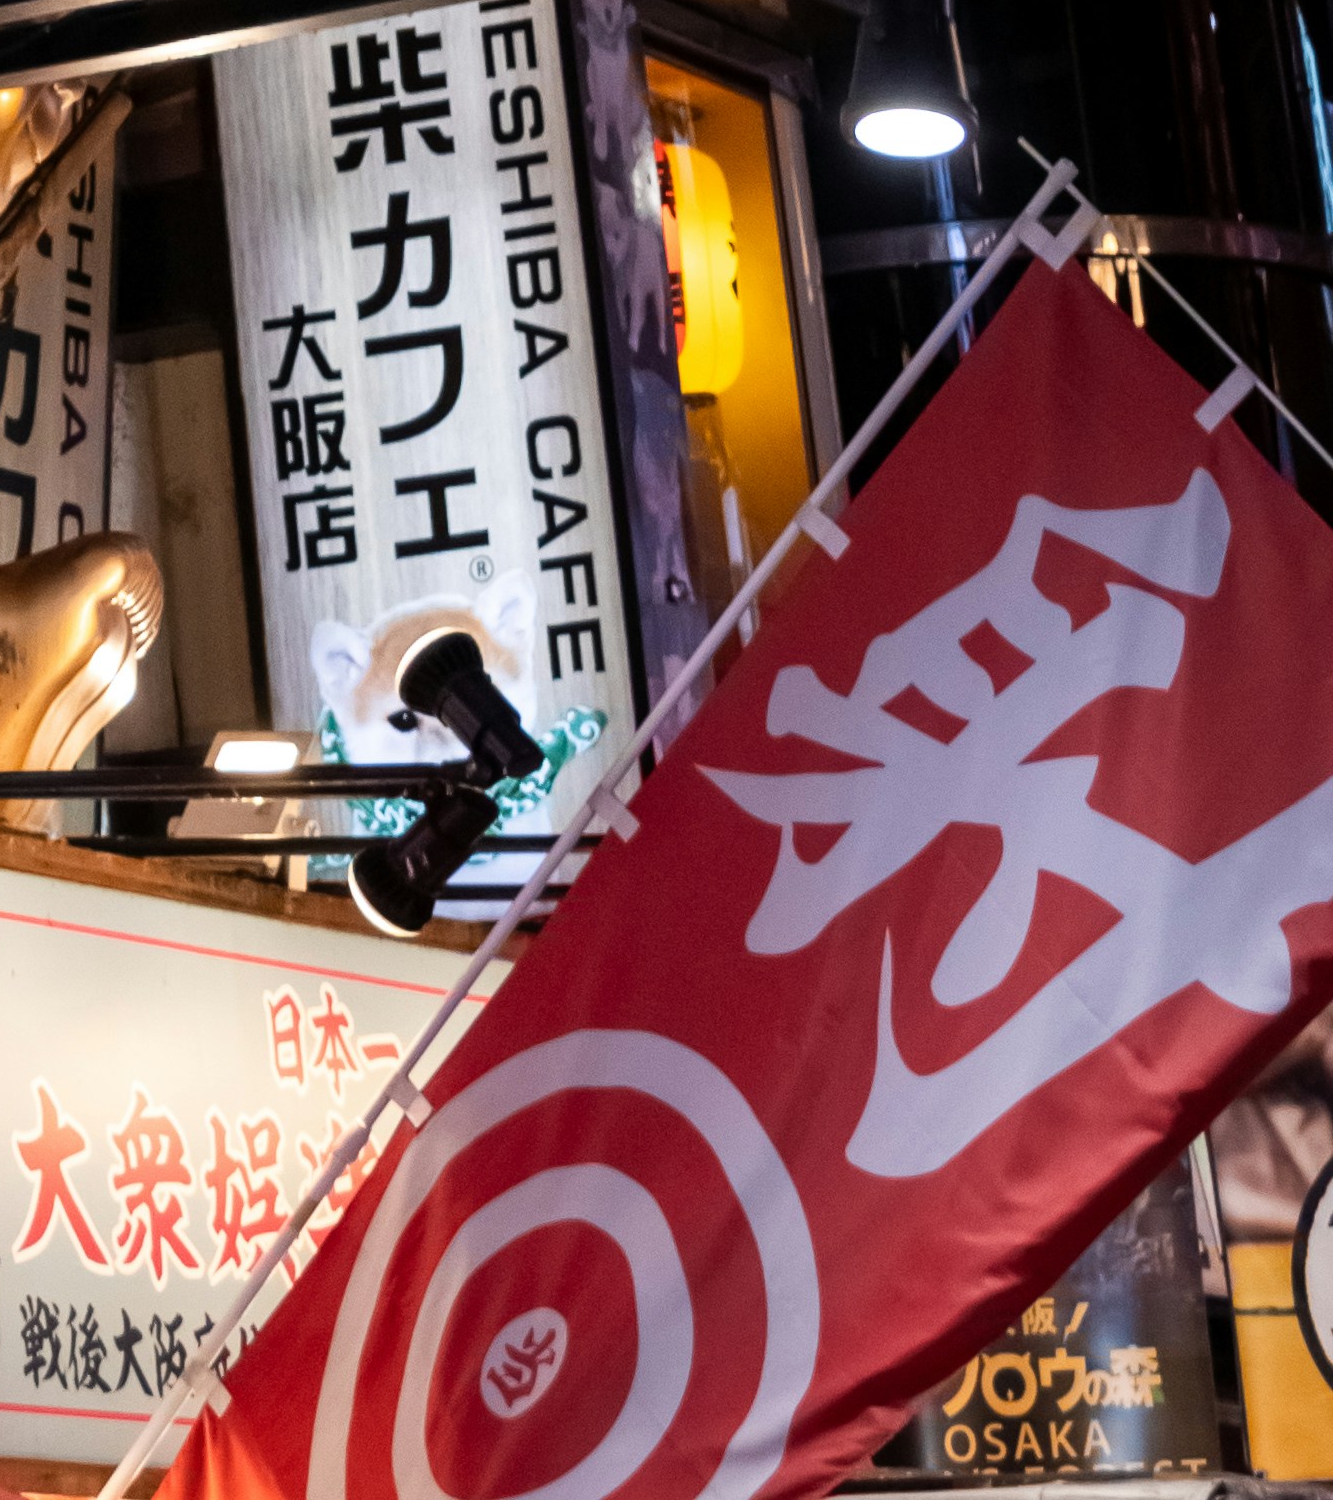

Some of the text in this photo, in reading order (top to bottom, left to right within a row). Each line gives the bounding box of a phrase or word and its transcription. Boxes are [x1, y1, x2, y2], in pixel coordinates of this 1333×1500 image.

[327, 26, 491, 560] 柴カフェ
[262, 304, 359, 574] 大阪店
[525, 413, 607, 683] CAFE
[263, 982, 401, 1098] 日本一
[943, 1419, 1112, 1463] OSAKA
